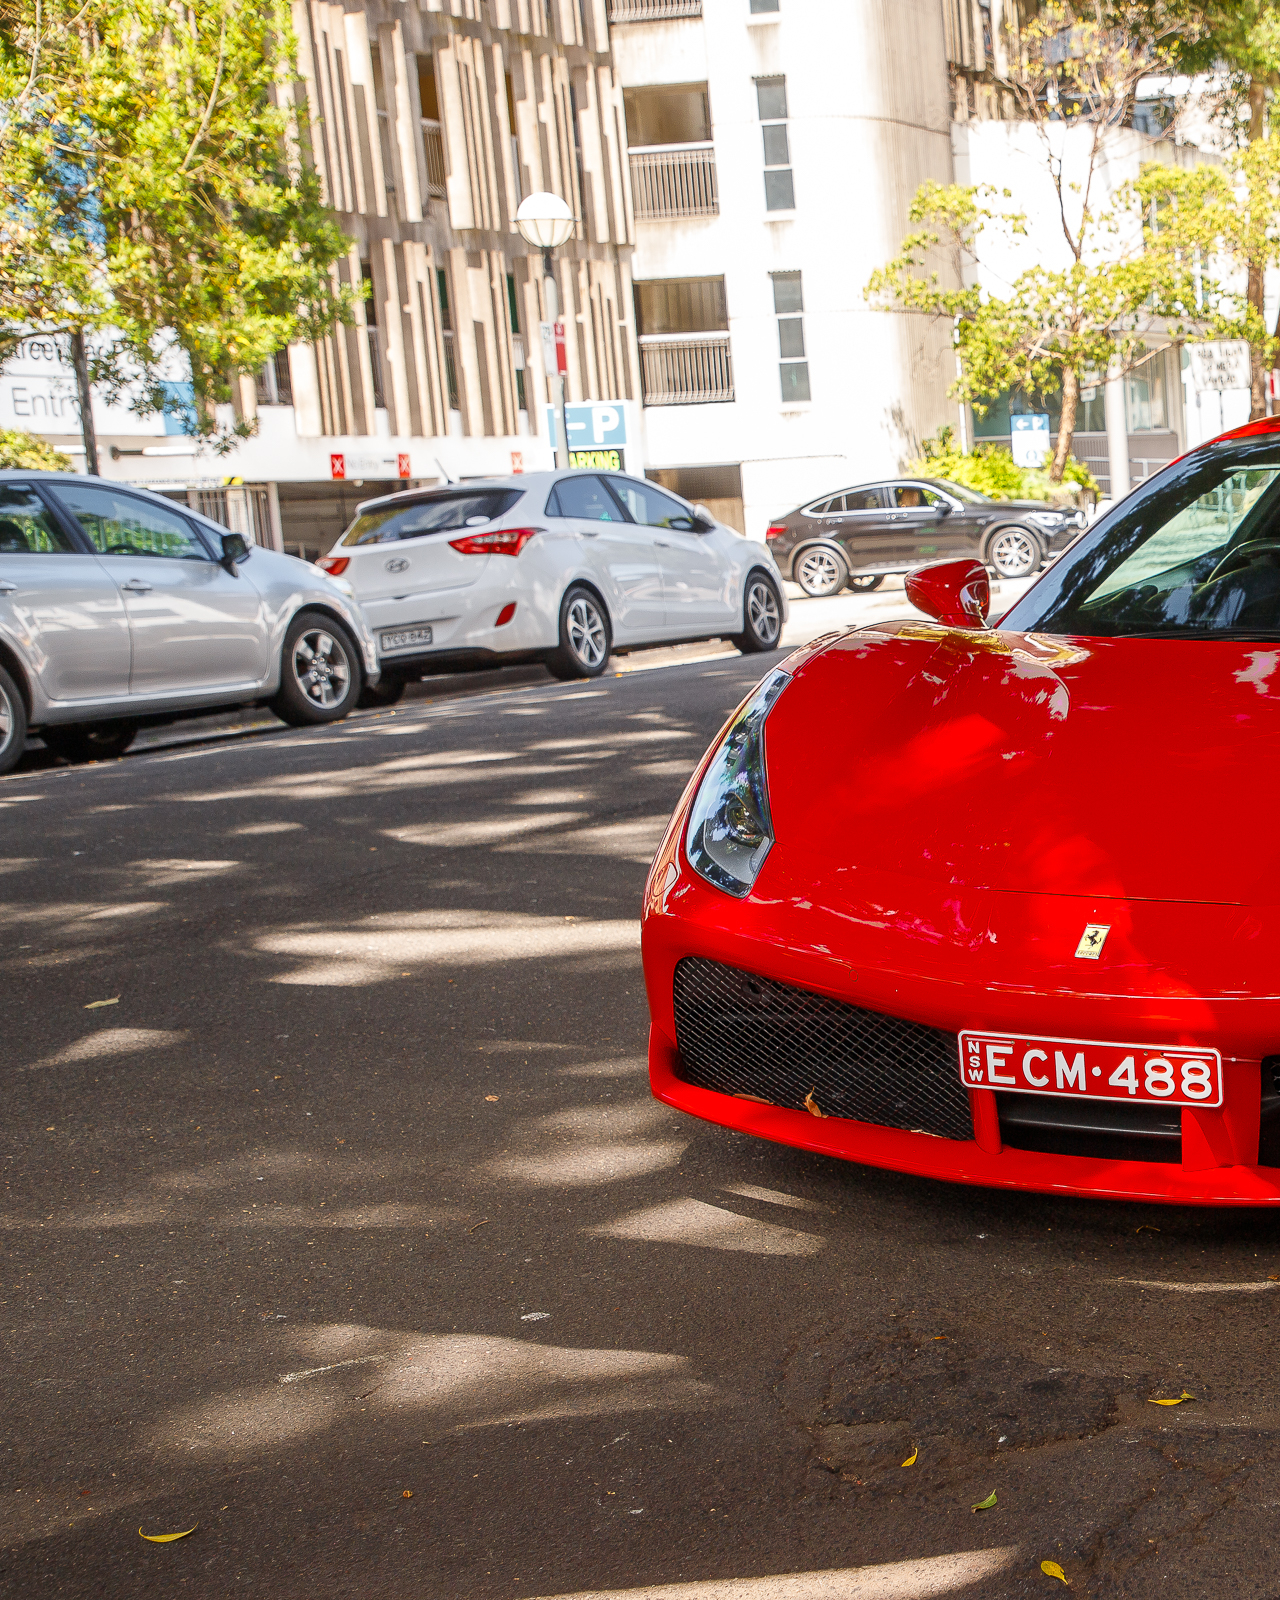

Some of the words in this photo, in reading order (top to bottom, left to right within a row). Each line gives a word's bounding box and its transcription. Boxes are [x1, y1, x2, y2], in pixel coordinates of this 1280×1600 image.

[12, 387, 83, 425] Entry
[592, 406, 620, 444] P
[569, 450, 621, 472] ARKING
[968, 1041, 984, 1082] NSW
